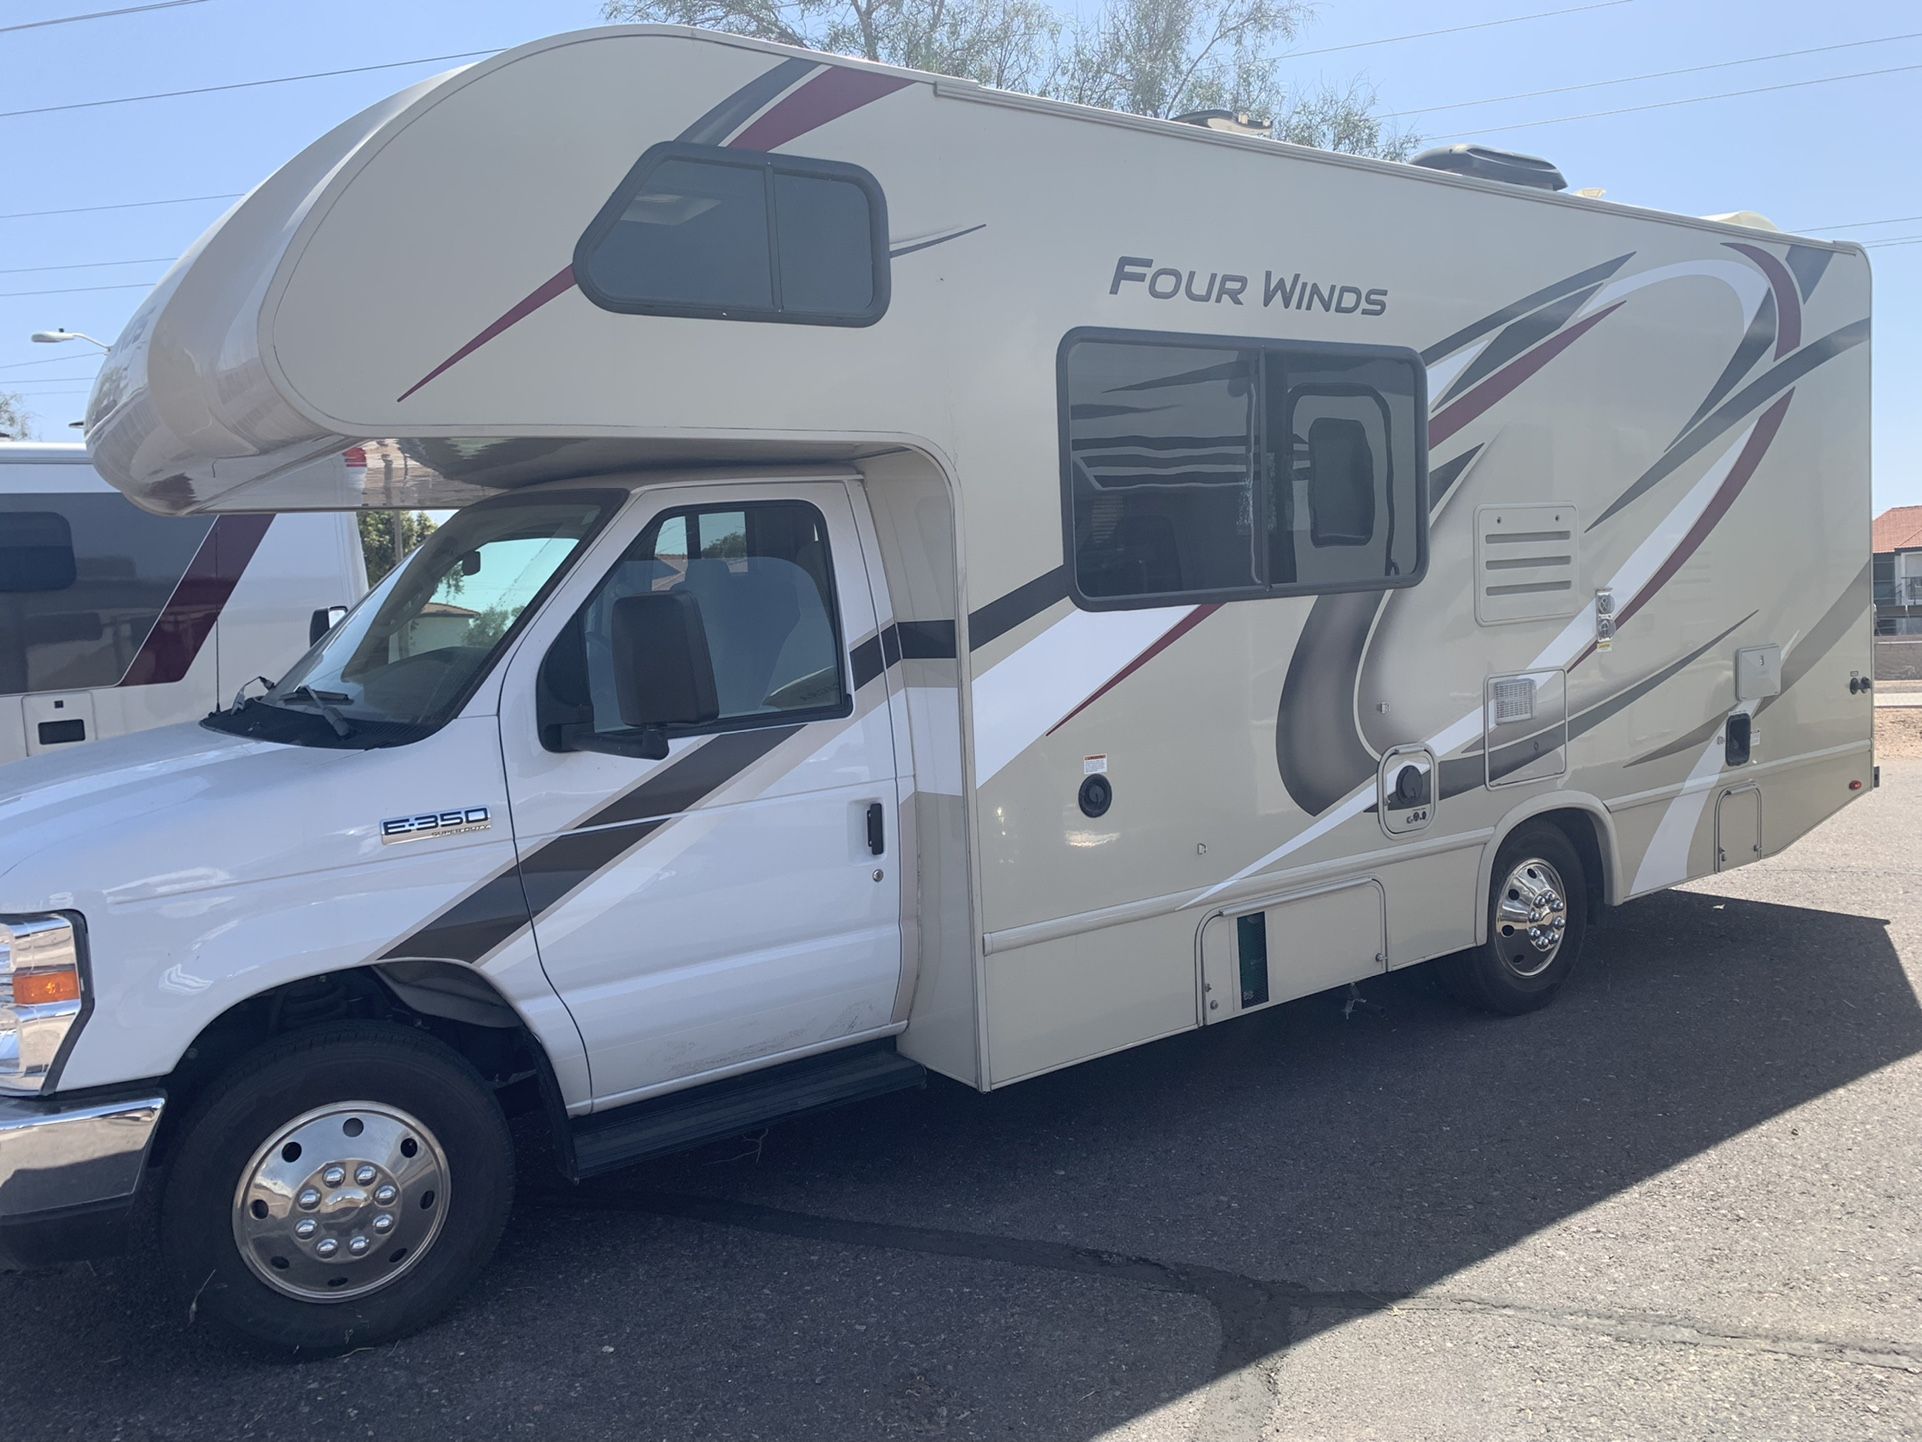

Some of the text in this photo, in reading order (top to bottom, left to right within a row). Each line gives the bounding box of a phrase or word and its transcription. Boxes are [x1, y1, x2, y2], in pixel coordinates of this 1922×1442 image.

[1109, 256, 1388, 316] FOUR WINDS
[383, 807, 489, 835] E-350
